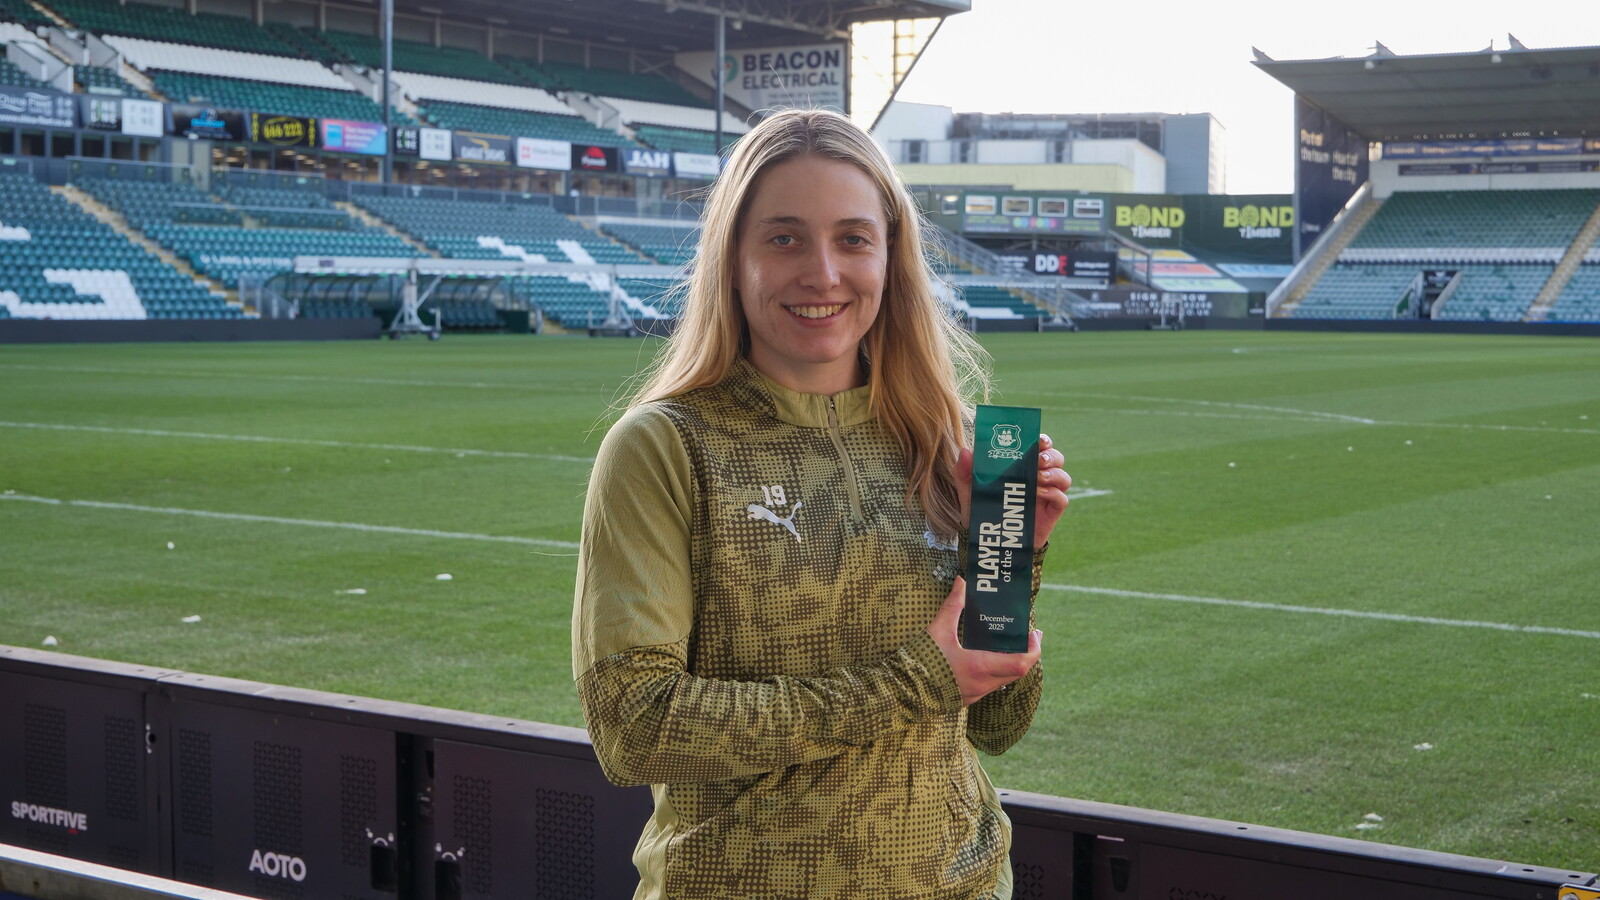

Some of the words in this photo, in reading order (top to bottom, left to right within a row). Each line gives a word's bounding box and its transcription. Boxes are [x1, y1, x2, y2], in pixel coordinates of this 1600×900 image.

[743, 50, 840, 72] BEACON
[743, 72, 839, 90] ELECTRICAL
[627, 150, 670, 169] JAH
[1115, 204, 1185, 228] BOND
[1223, 204, 1295, 228] BOND
[1131, 225, 1172, 239] TIMBER
[1239, 225, 1282, 239] TIMBER
[761, 485, 787, 506] 19
[1001, 482, 1026, 548] MONTH
[976, 522, 1001, 592] PLAYER
[1001, 550, 1013, 568] the
[1003, 569, 1012, 583] of
[979, 614, 1015, 624] December
[988, 623, 1005, 631] 2025
[11, 801, 88, 831] SPORTFIVE
[249, 849, 307, 882] AOTO
